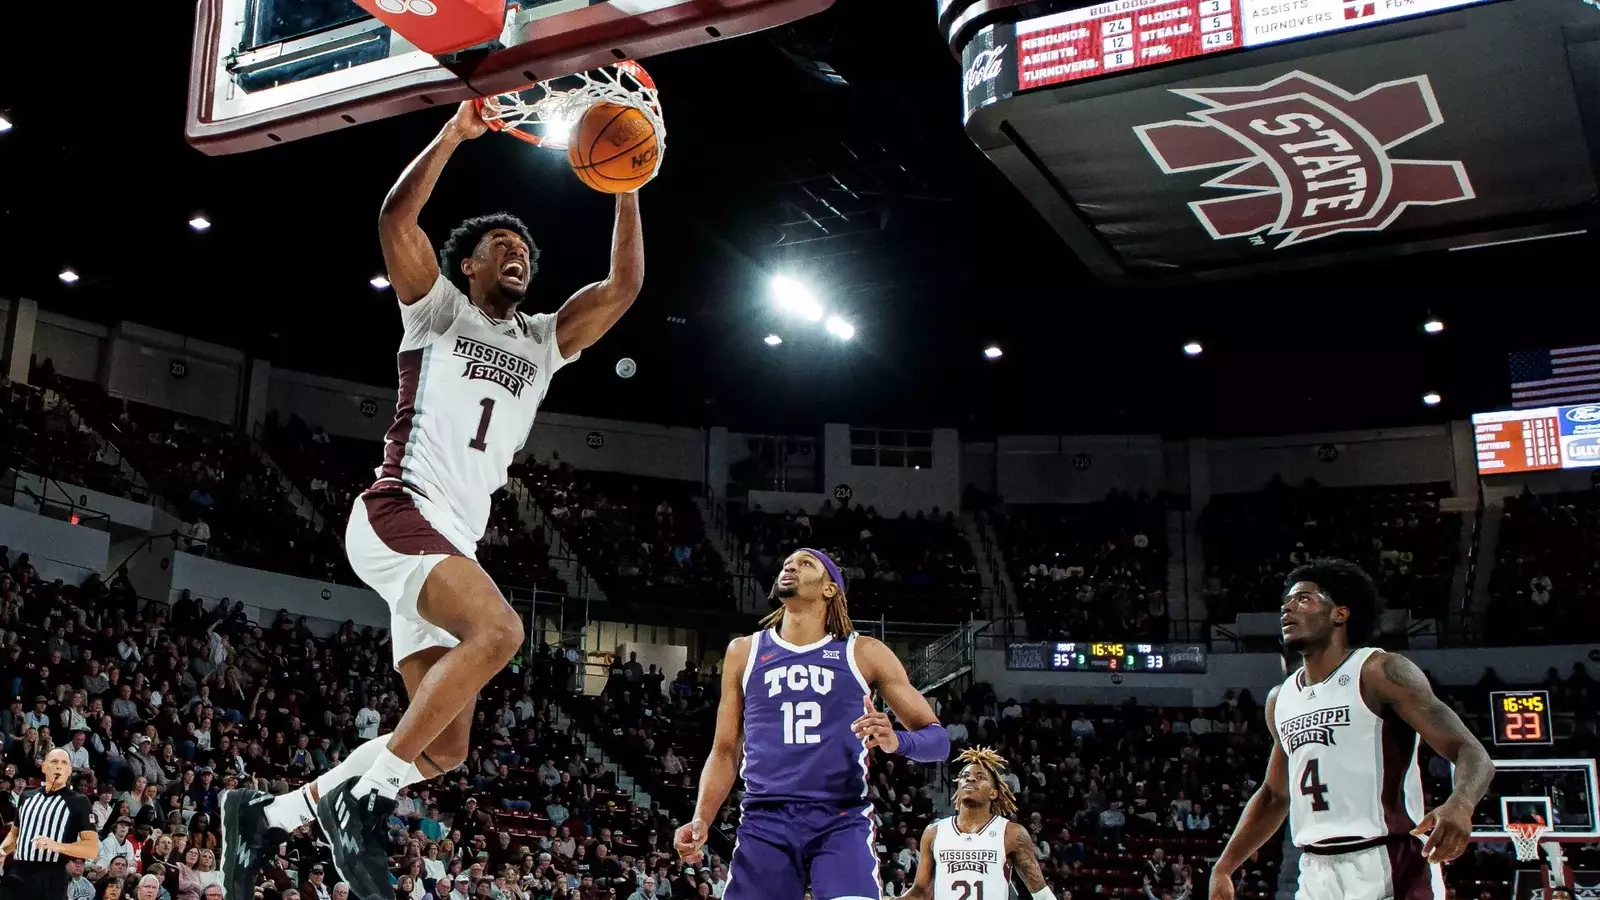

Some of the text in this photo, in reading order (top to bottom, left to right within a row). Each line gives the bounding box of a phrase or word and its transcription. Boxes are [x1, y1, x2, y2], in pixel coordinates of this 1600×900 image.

[1212, 1, 1219, 11] 3
[1252, 0, 1308, 18] ASSISTS
[1109, 21, 1125, 33] 24
[1213, 18, 1220, 28] 5
[1253, 12, 1332, 35] TURNOVERS
[1112, 38, 1124, 48] 12
[1249, 112, 1367, 218] STATE
[453, 339, 538, 383] MISSISSIPPI
[171, 362, 185, 376] 231
[474, 366, 517, 391] STATE
[361, 403, 376, 415] 232
[468, 397, 497, 453] 1
[588, 435, 602, 446] 233
[836, 488, 851, 498] 234
[1092, 644, 1124, 657] 16:45
[1054, 654, 1069, 666] 35
[1078, 655, 1085, 664] 3
[1109, 659, 1116, 668] 2
[1127, 655, 1134, 665] 3
[1147, 655, 1163, 668] 33
[764, 664, 834, 698] TCU
[1503, 696, 1543, 712] 16:45
[780, 701, 821, 744] 12
[1280, 709, 1350, 736] MISSISSIPPI
[1506, 713, 1541, 739] 23
[1292, 729, 1325, 748] STATE
[1300, 758, 1329, 812] 4
[939, 851, 997, 861] MISSISSIPPI
[953, 862, 981, 871] STATE
[951, 880, 984, 900] 21
